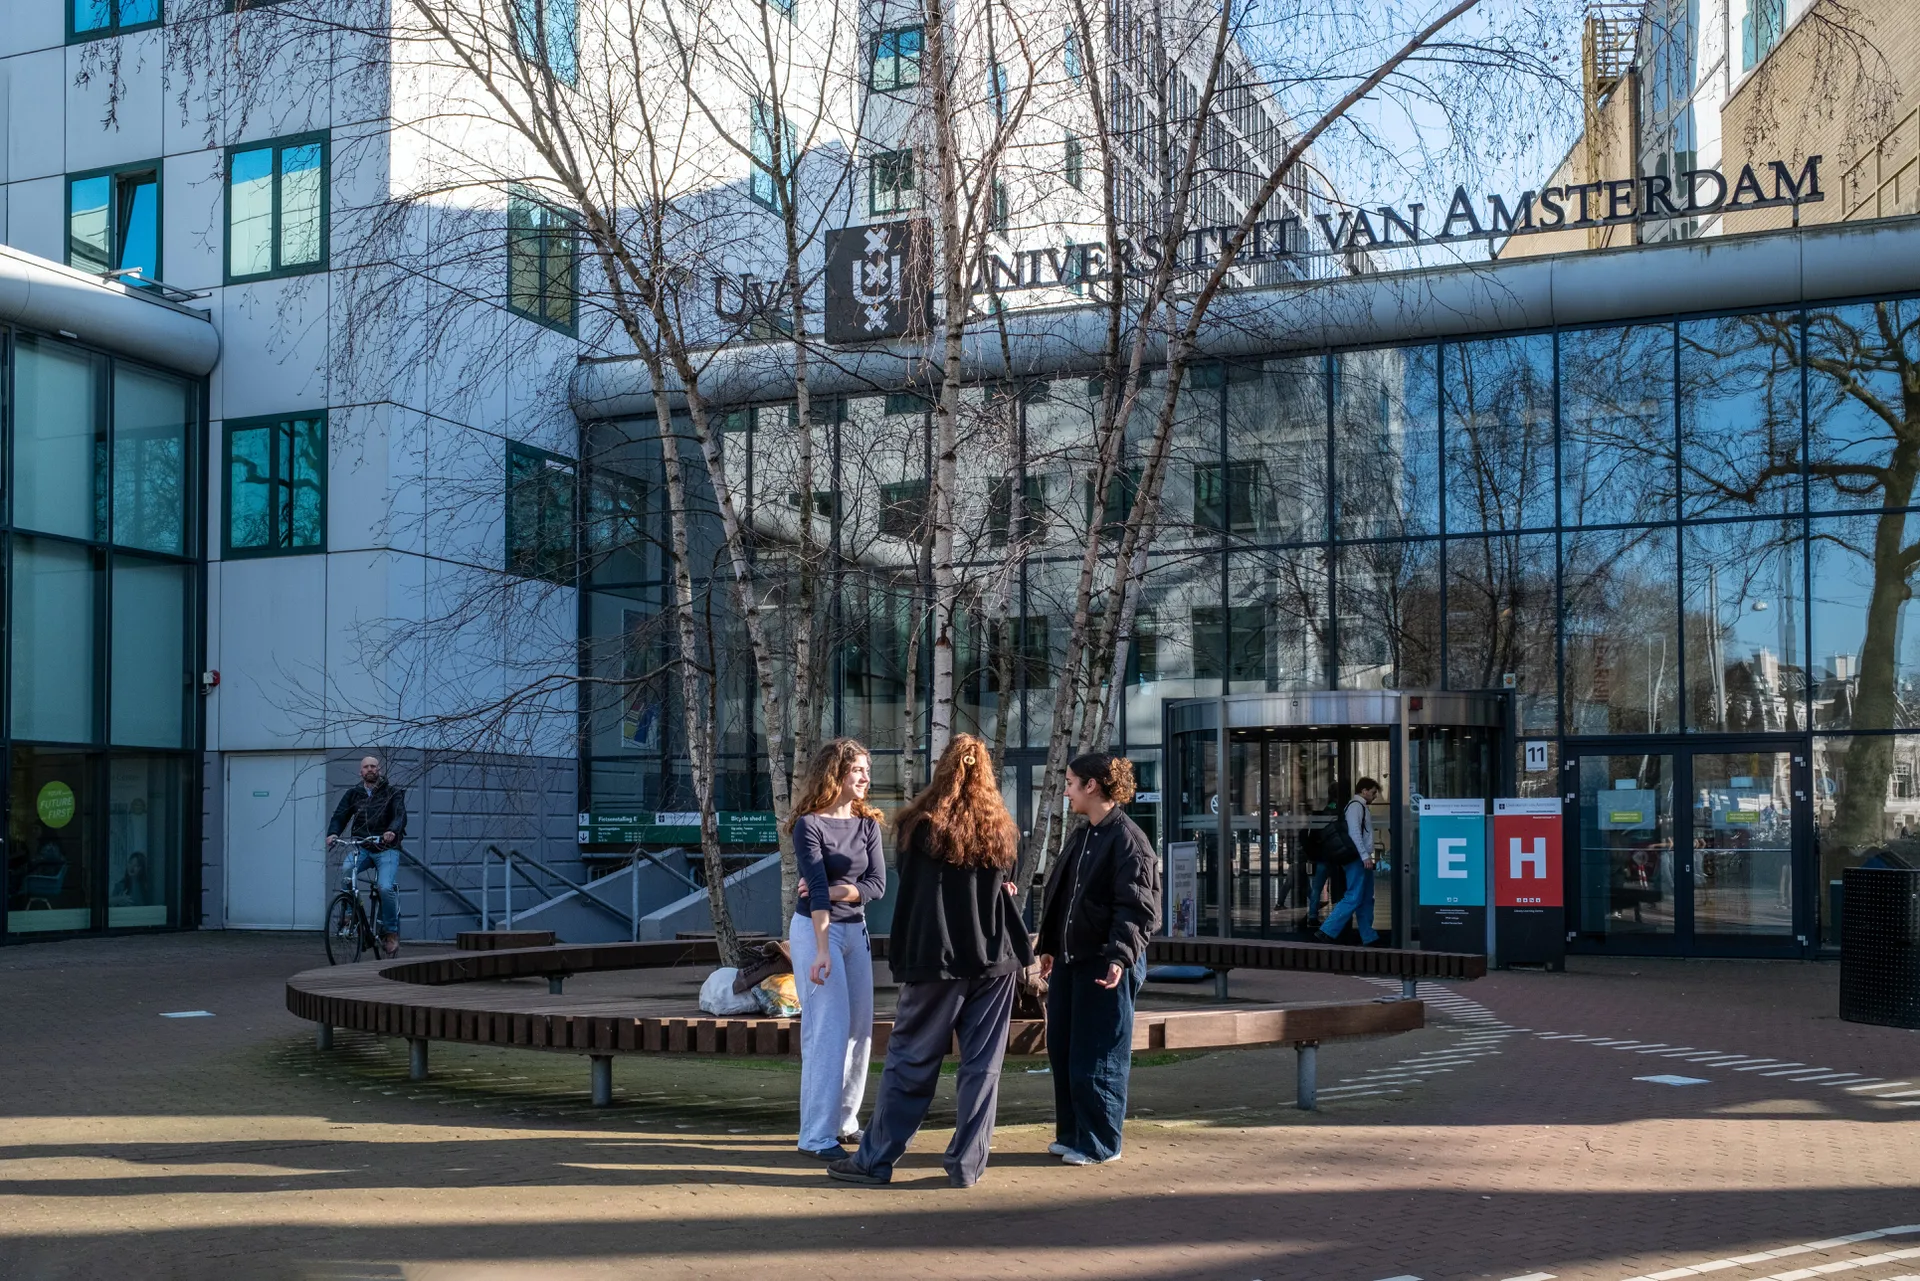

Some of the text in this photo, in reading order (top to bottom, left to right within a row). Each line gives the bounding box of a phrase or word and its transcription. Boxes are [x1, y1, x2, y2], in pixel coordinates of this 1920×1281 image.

[960, 154, 1826, 294] NIVERSTEIT VAN AMSTERDAM
[1528, 746, 1544, 762] 11
[40, 796, 72, 809] FUTURE
[48, 807, 72, 819] FIRST
[1437, 837, 1468, 878] E
[1509, 837, 1547, 878] H
